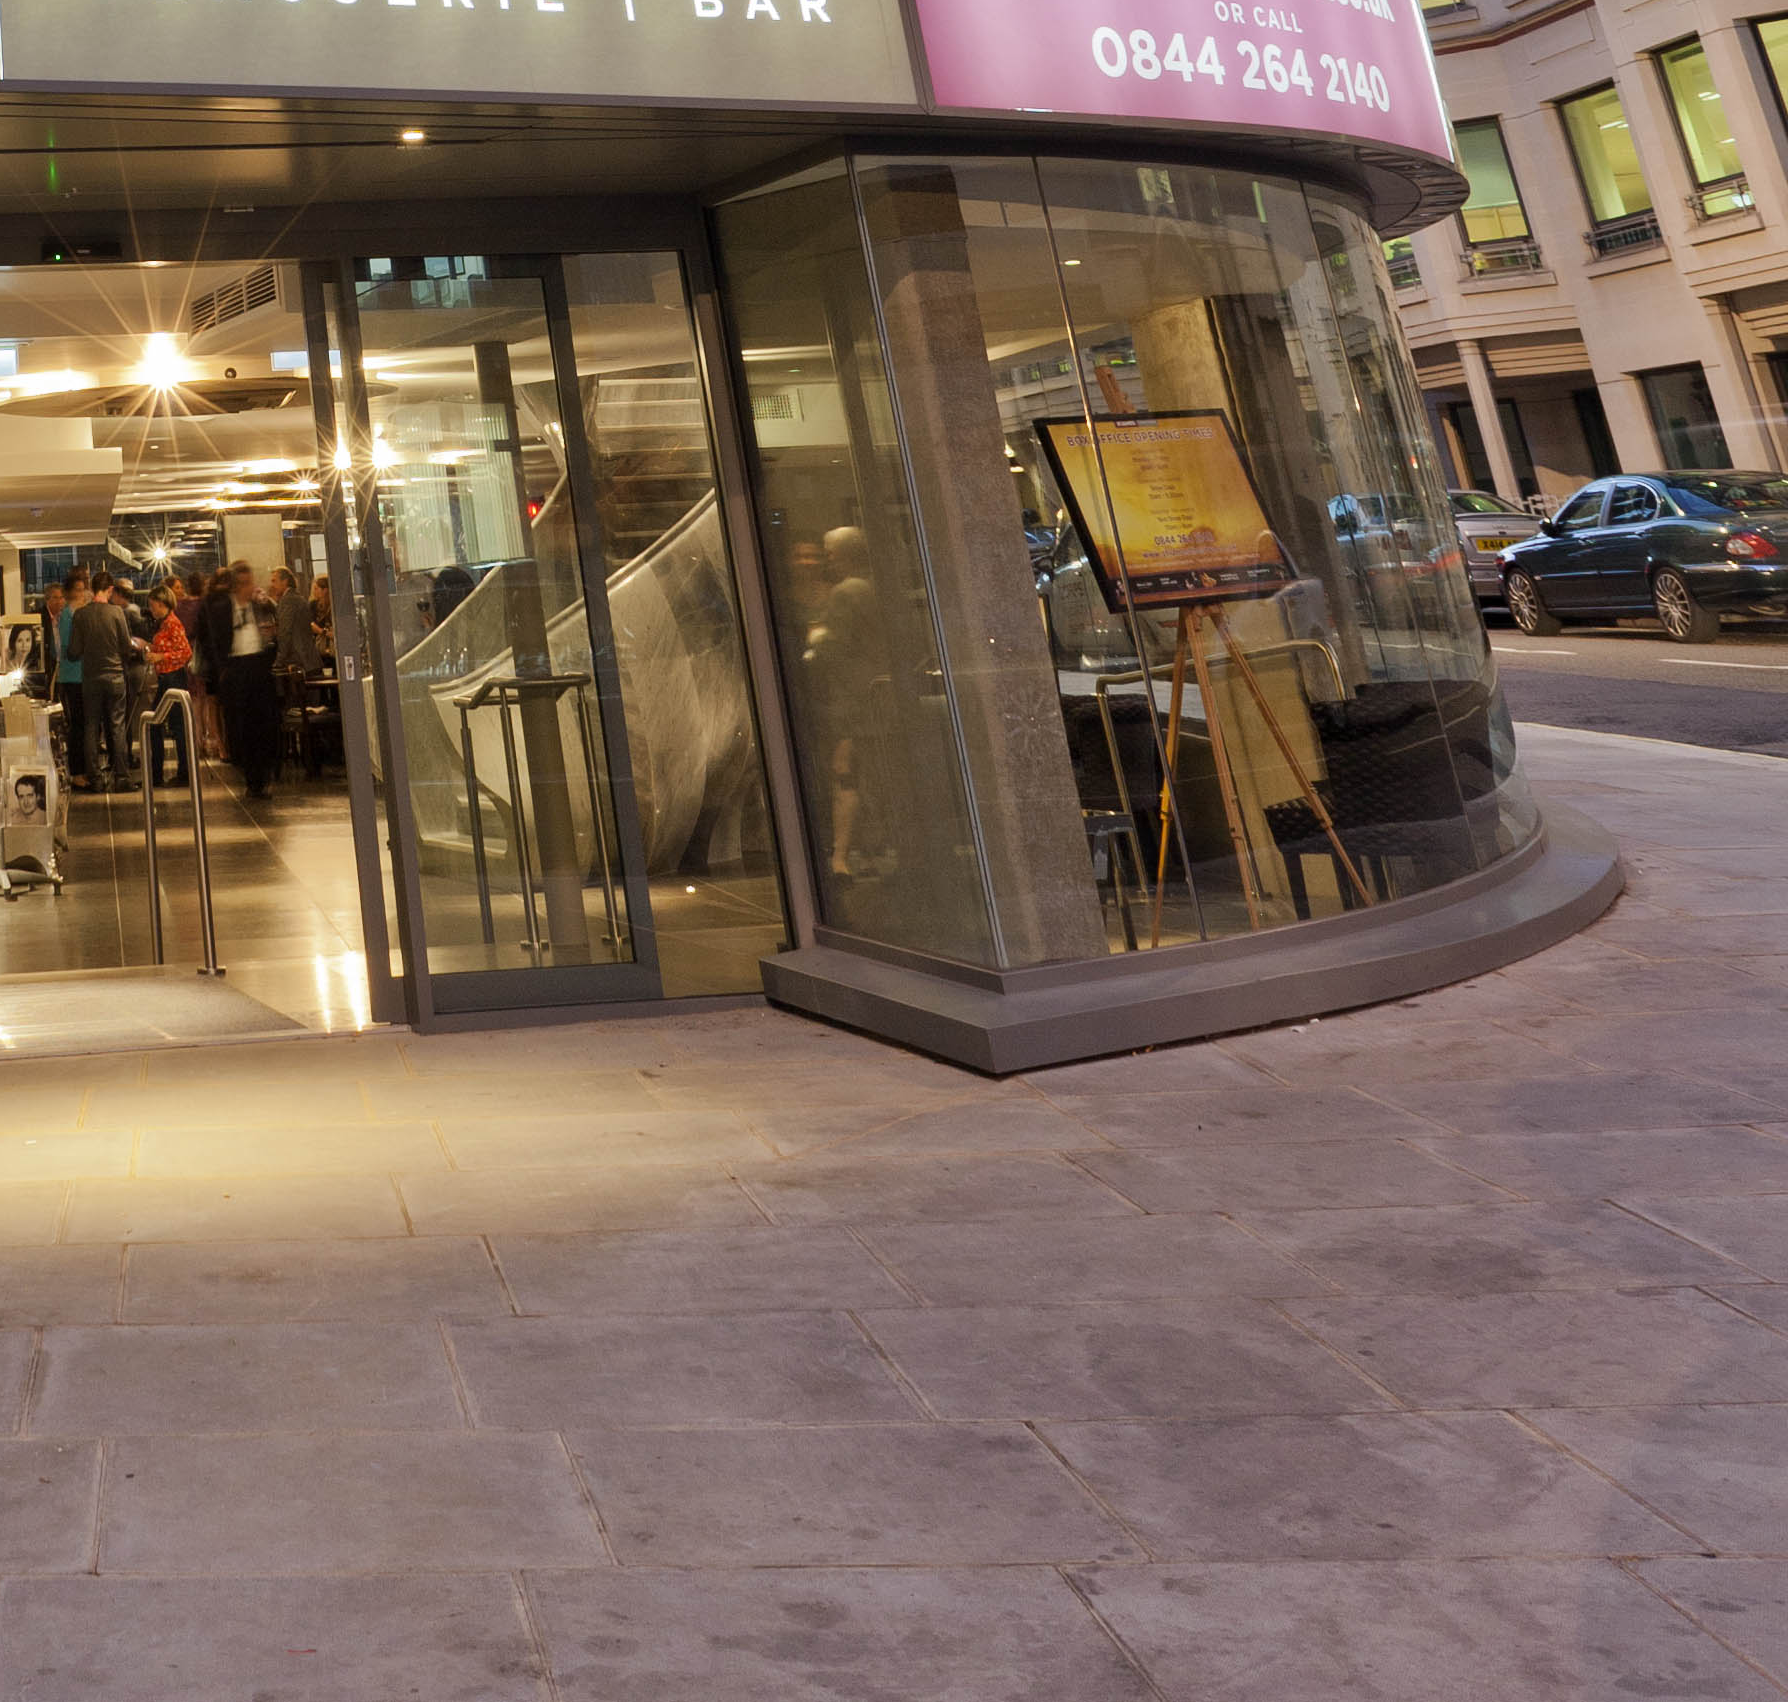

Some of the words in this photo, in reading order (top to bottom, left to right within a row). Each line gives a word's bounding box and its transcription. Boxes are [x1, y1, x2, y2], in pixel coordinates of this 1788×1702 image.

[1214, 0, 1245, 24] OR
[1253, 6, 1303, 34] CALL
[1091, 26, 1226, 85] 0844
[1236, 40, 1314, 97] 264
[1319, 53, 1390, 113] 2140
[1067, 435, 1090, 446] BOX
